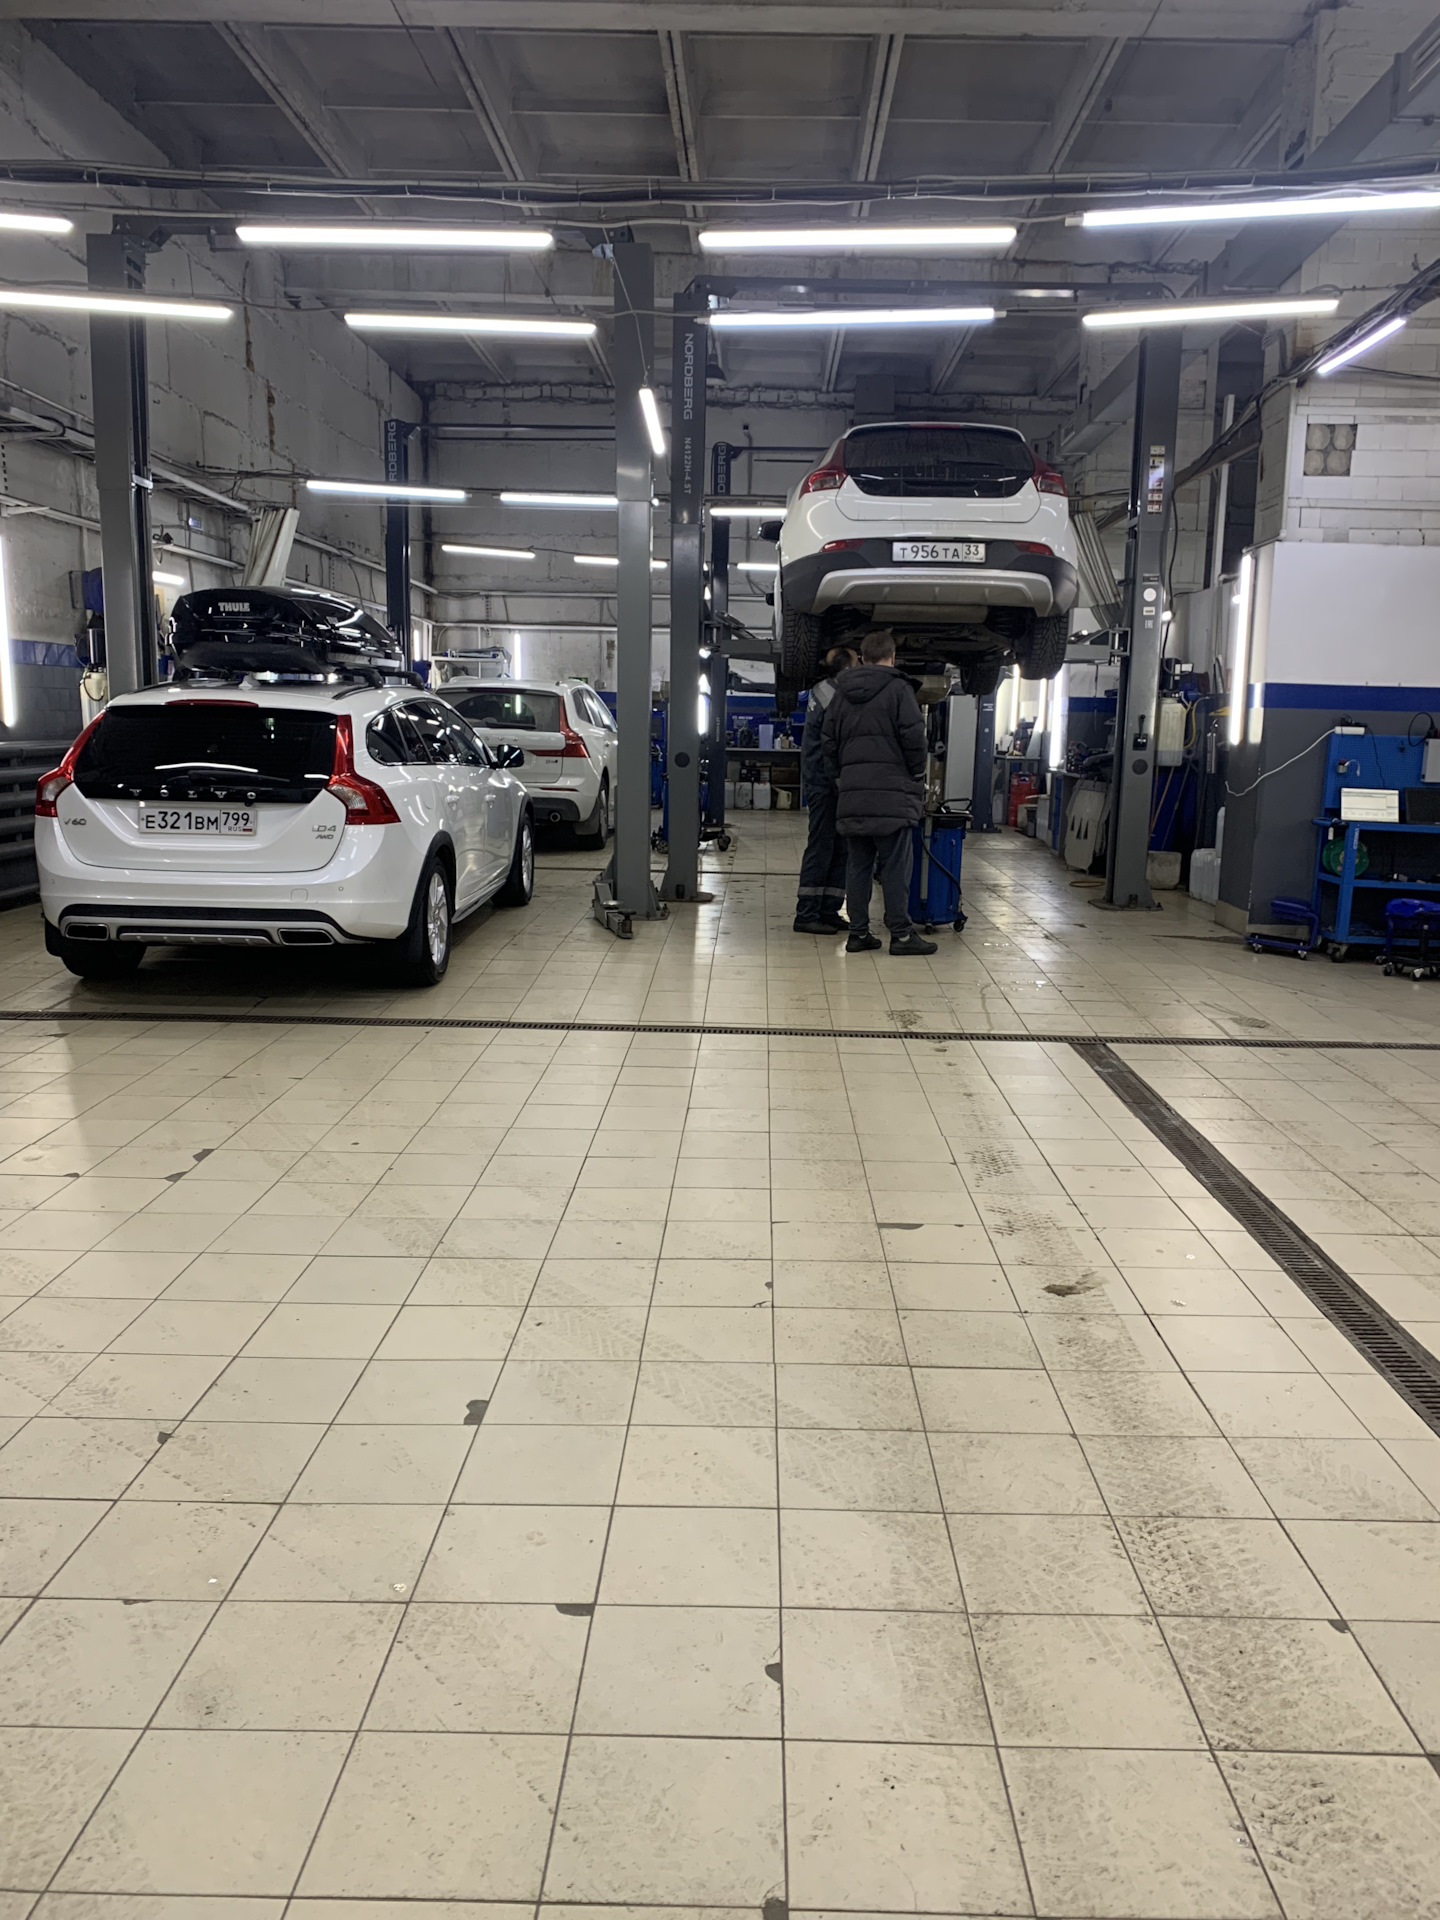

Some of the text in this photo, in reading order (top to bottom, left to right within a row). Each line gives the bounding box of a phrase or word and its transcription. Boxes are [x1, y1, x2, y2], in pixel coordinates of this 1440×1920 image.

[683, 333, 694, 420] NORDBERG
[387, 421, 398, 482] RDBERG
[964, 544, 980, 556] 33
[217, 602, 251, 612] THULE
[63, 818, 87, 826] V60
[222, 812, 250, 826] 799
